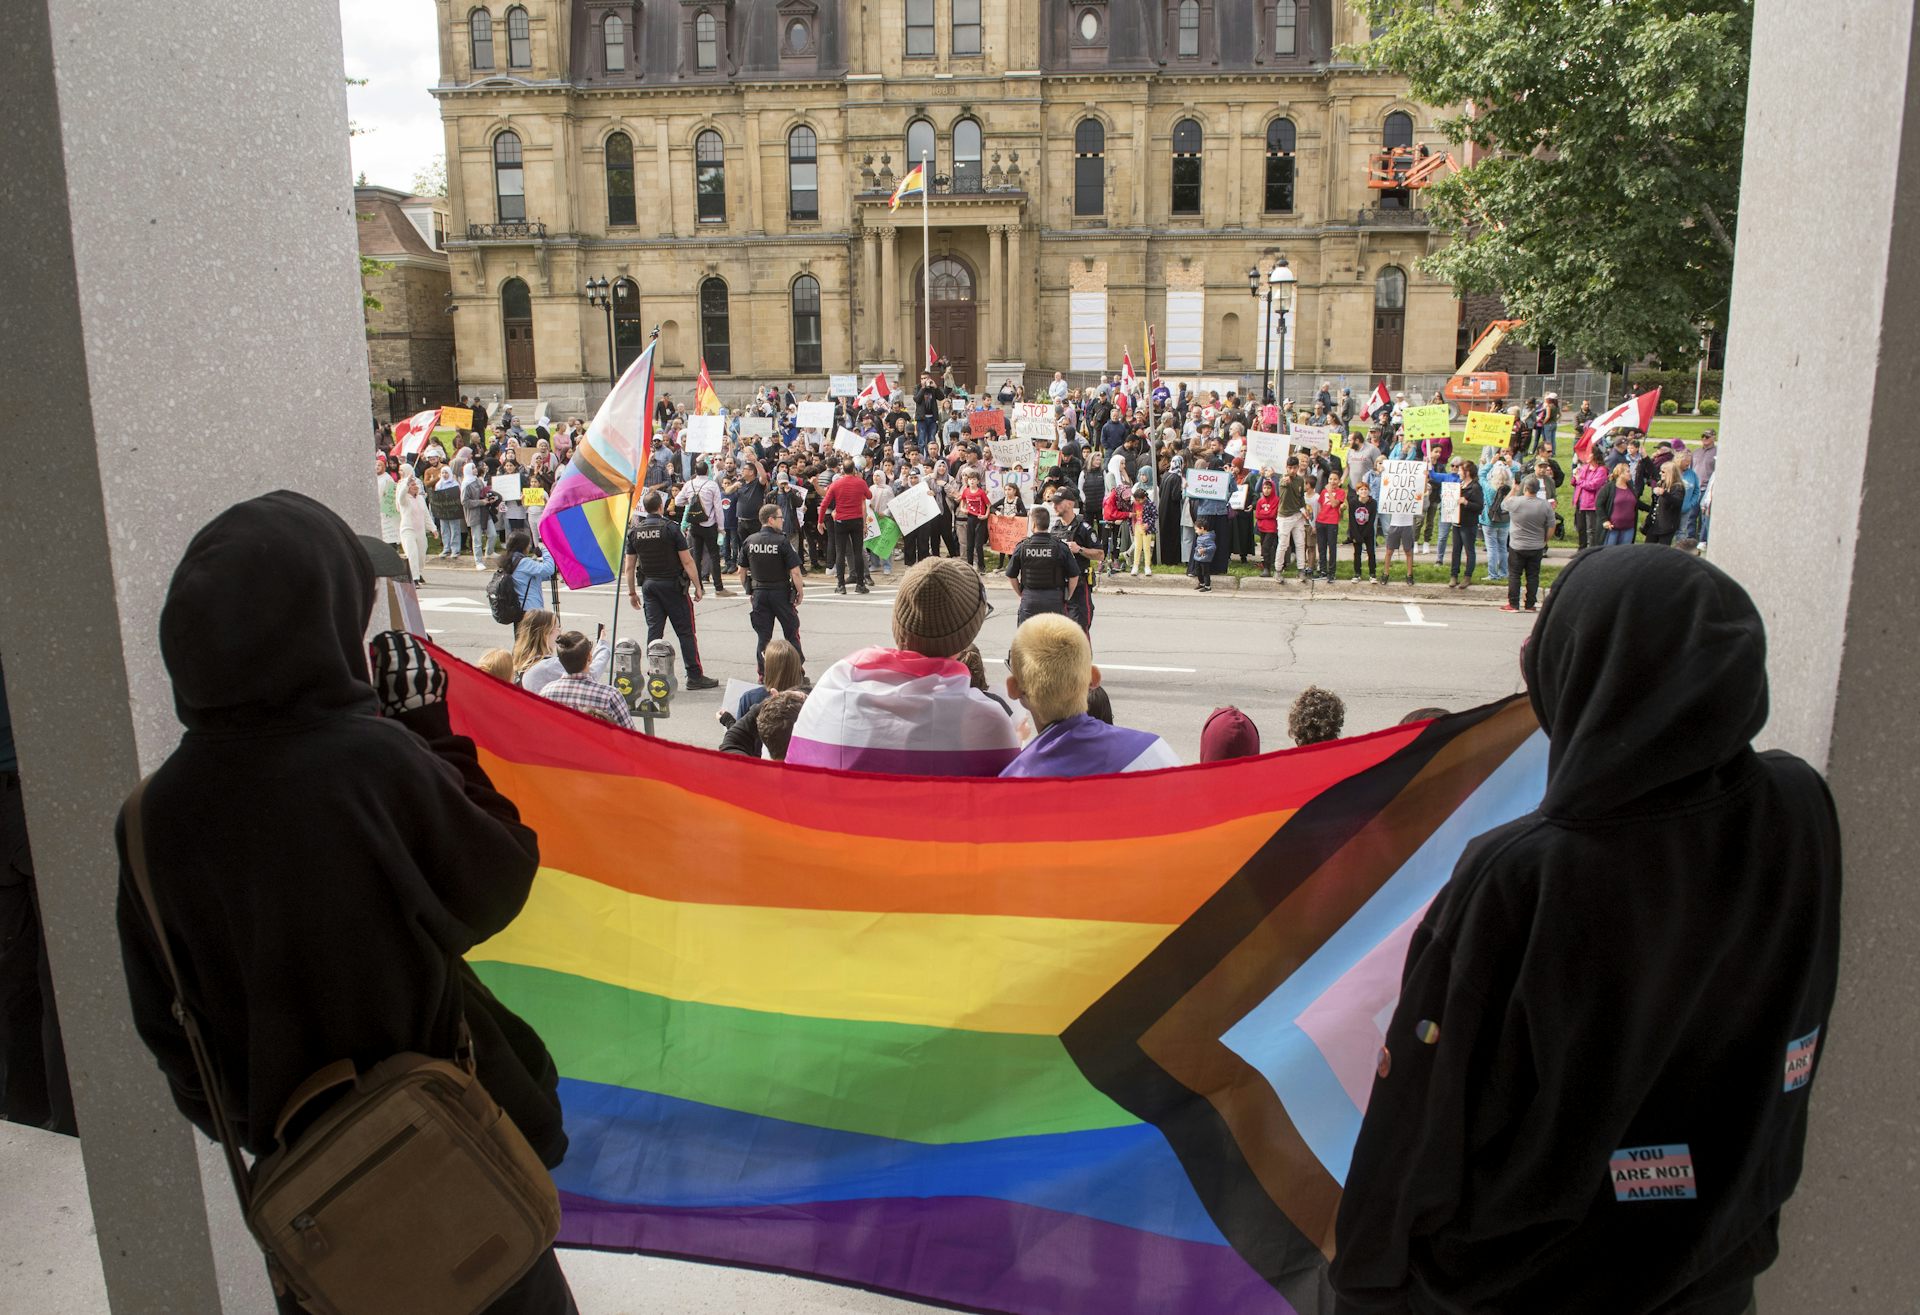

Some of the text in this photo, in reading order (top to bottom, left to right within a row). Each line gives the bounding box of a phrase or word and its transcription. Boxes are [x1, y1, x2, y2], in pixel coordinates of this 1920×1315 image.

[1022, 404, 1048, 418] STOP
[1035, 423, 1052, 436] KIDS
[992, 440, 1031, 455] PARENTS
[1015, 452, 1032, 463] BEST
[1388, 462, 1423, 475] LEAVE
[989, 471, 1031, 488] STOP
[1197, 474, 1218, 483] SOGI
[1392, 475, 1416, 488] OUR
[1194, 487, 1218, 495] Schools
[1386, 488, 1417, 502] KIDS
[1381, 502, 1419, 514] ALONE
[636, 529, 661, 540] POLICE
[749, 543, 778, 554] POLICE
[1026, 548, 1052, 557] POLICE
[1788, 1055, 1808, 1073] ARE
[1628, 1148, 1665, 1162] YOU
[1616, 1165, 1690, 1182] ARE NOT
[1627, 1184, 1687, 1199] ALONE
